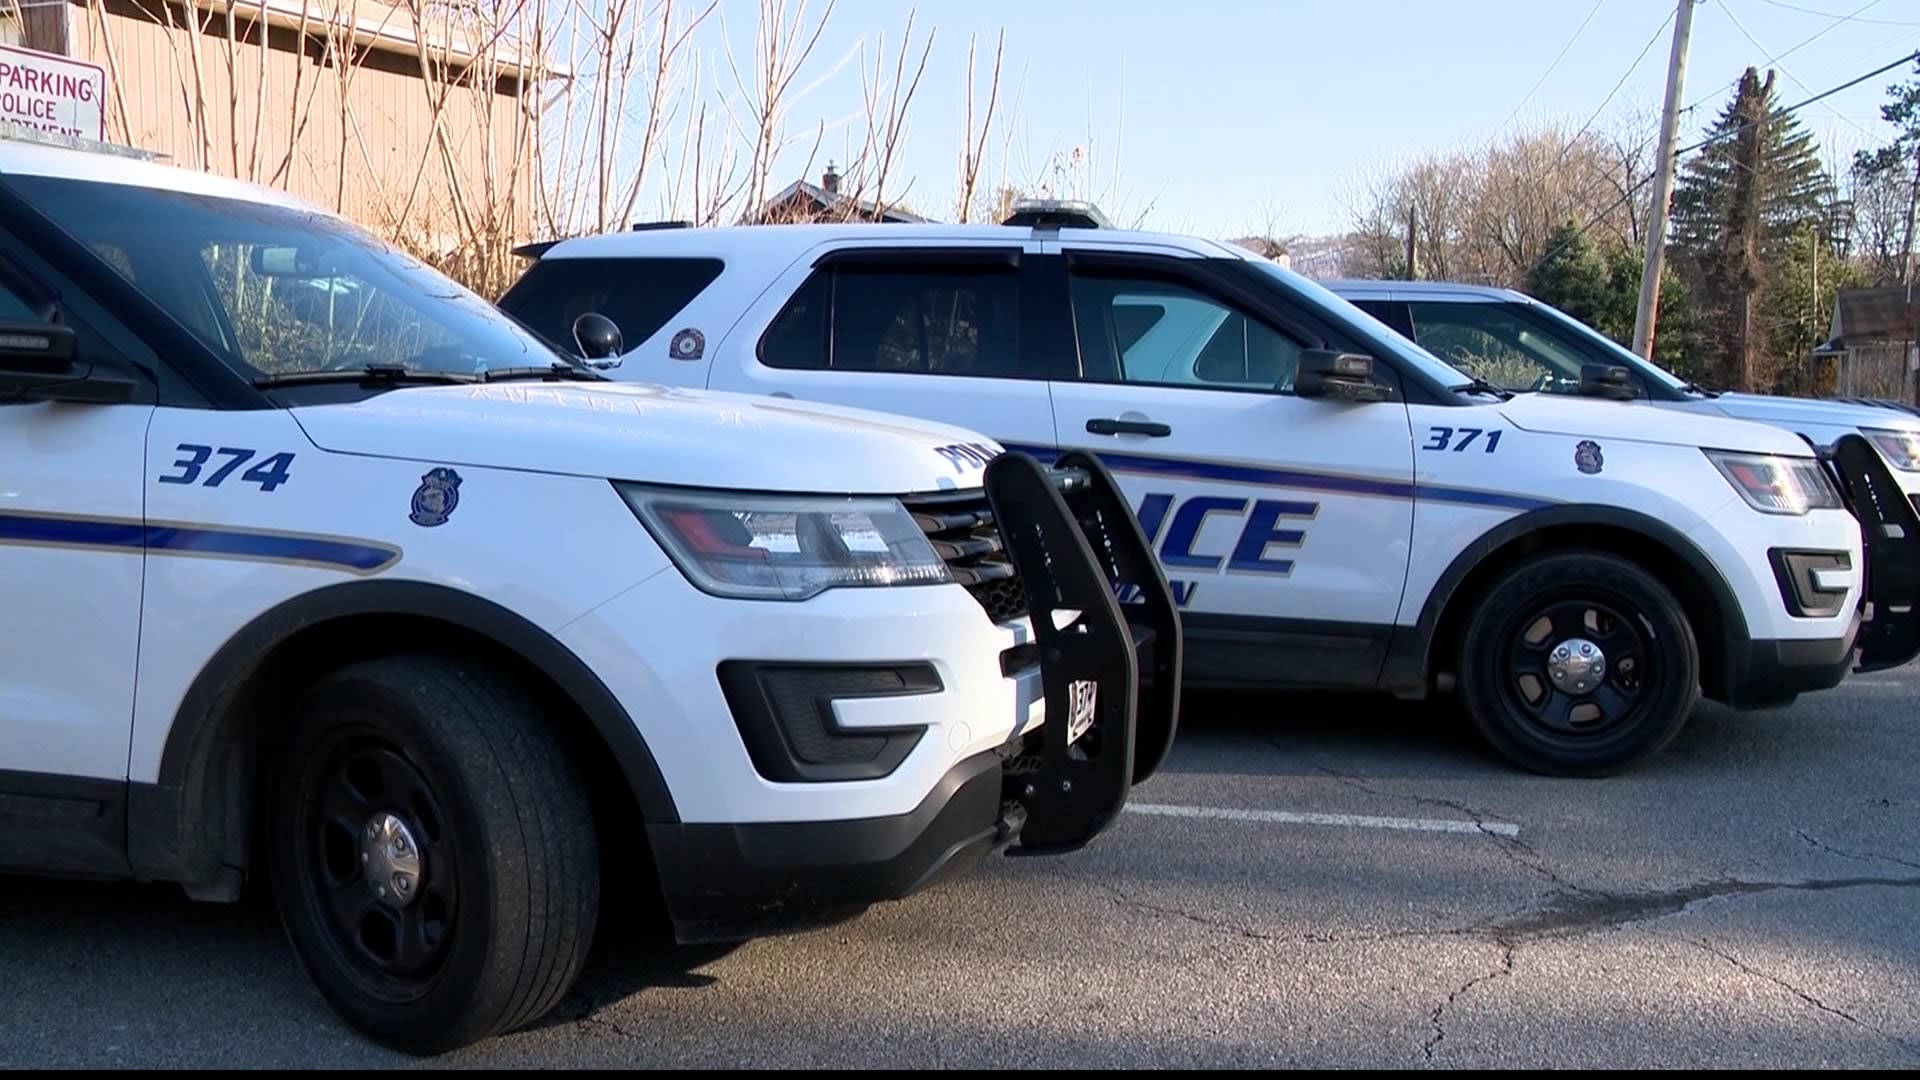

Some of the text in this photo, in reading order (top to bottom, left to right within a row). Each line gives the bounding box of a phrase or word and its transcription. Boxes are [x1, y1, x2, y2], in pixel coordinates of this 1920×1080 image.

[0, 62, 92, 102] PARKING
[0, 92, 57, 121] OLICE
[1422, 426, 1503, 453] 371
[158, 443, 296, 492] 374
[1136, 492, 1321, 579] ICE
